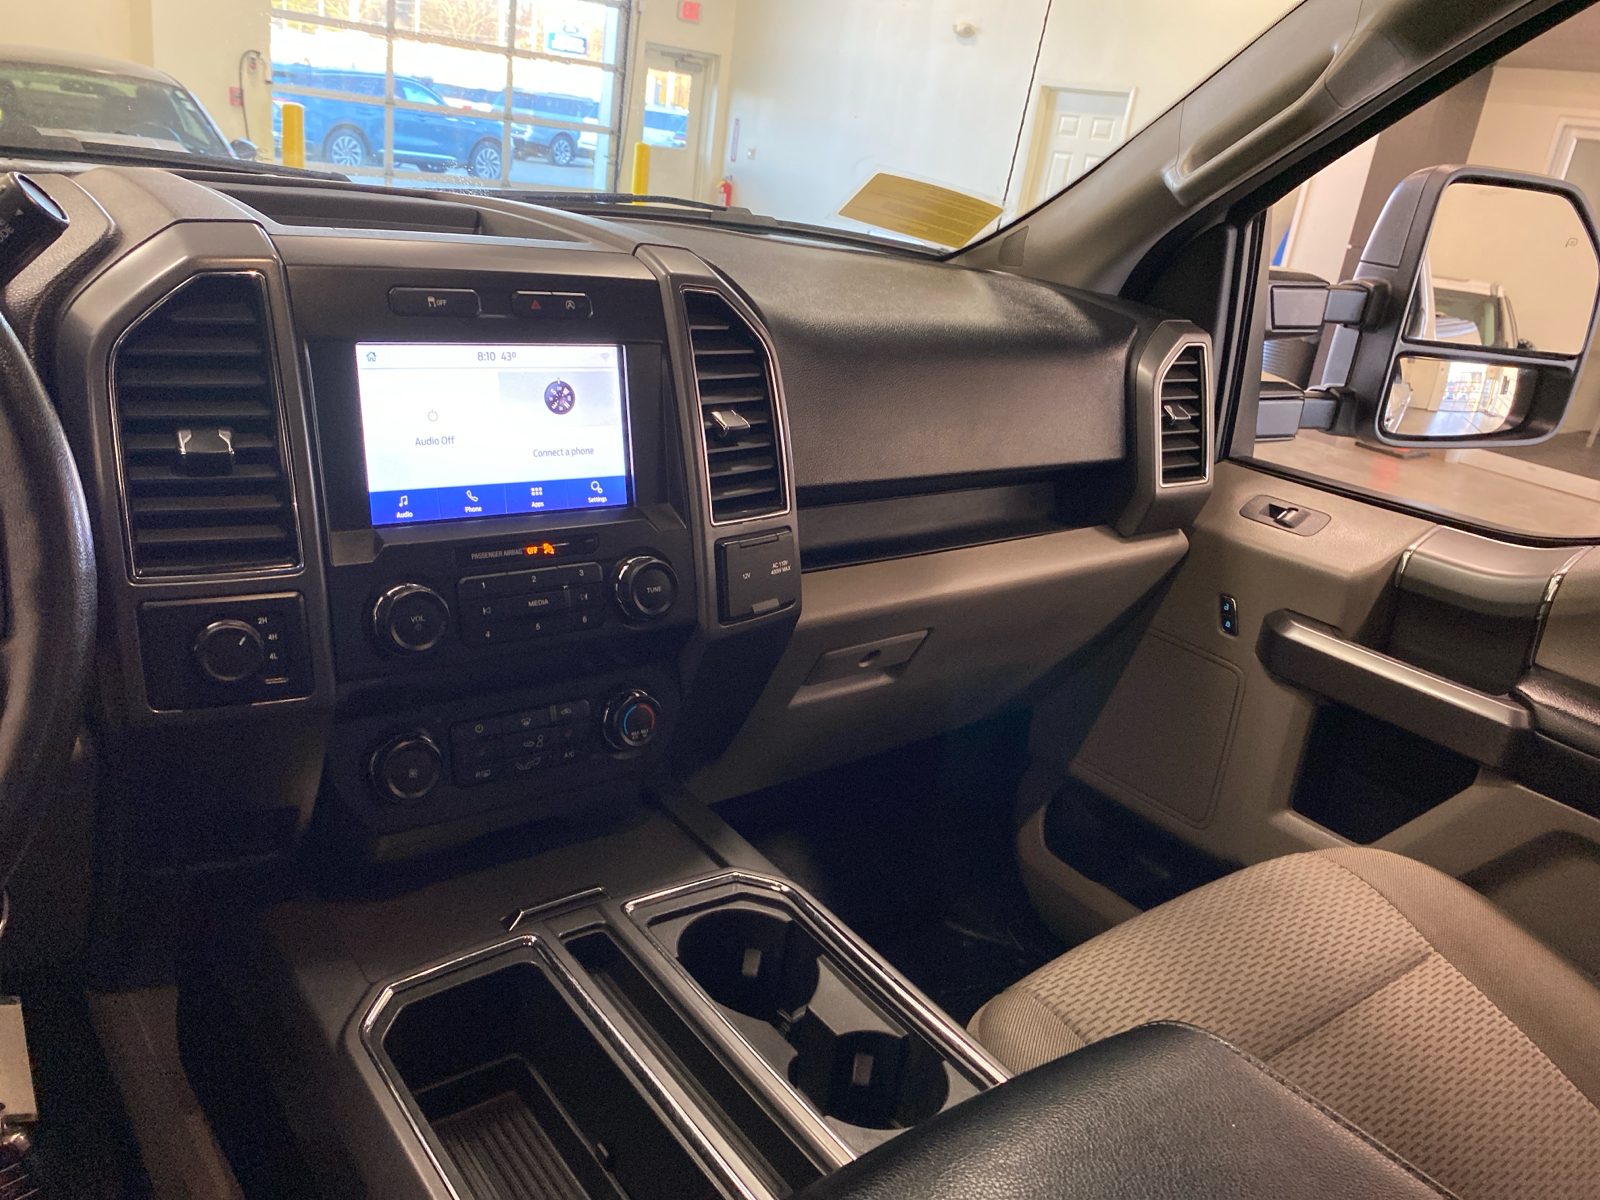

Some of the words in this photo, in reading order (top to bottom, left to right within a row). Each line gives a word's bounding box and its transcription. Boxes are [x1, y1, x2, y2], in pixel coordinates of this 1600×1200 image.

[477, 351, 496, 361] 8:10
[415, 437, 440, 446] Audio
[441, 436, 455, 445] Off
[532, 448, 564, 458] Connect
[571, 447, 595, 458] phone
[588, 495, 607, 503] Settings
[531, 500, 544, 508] Apps
[464, 505, 482, 513] Phone
[396, 510, 413, 518] Audio
[471, 550, 502, 560] PASSENGER
[503, 548, 523, 557] AIRBAG
[526, 546, 538, 555] OFF
[528, 599, 549, 607] MEDIA
[257, 616, 268, 625] 2H
[410, 615, 425, 623] VOL
[267, 633, 278, 641] 4H
[269, 652, 278, 660] 4L
